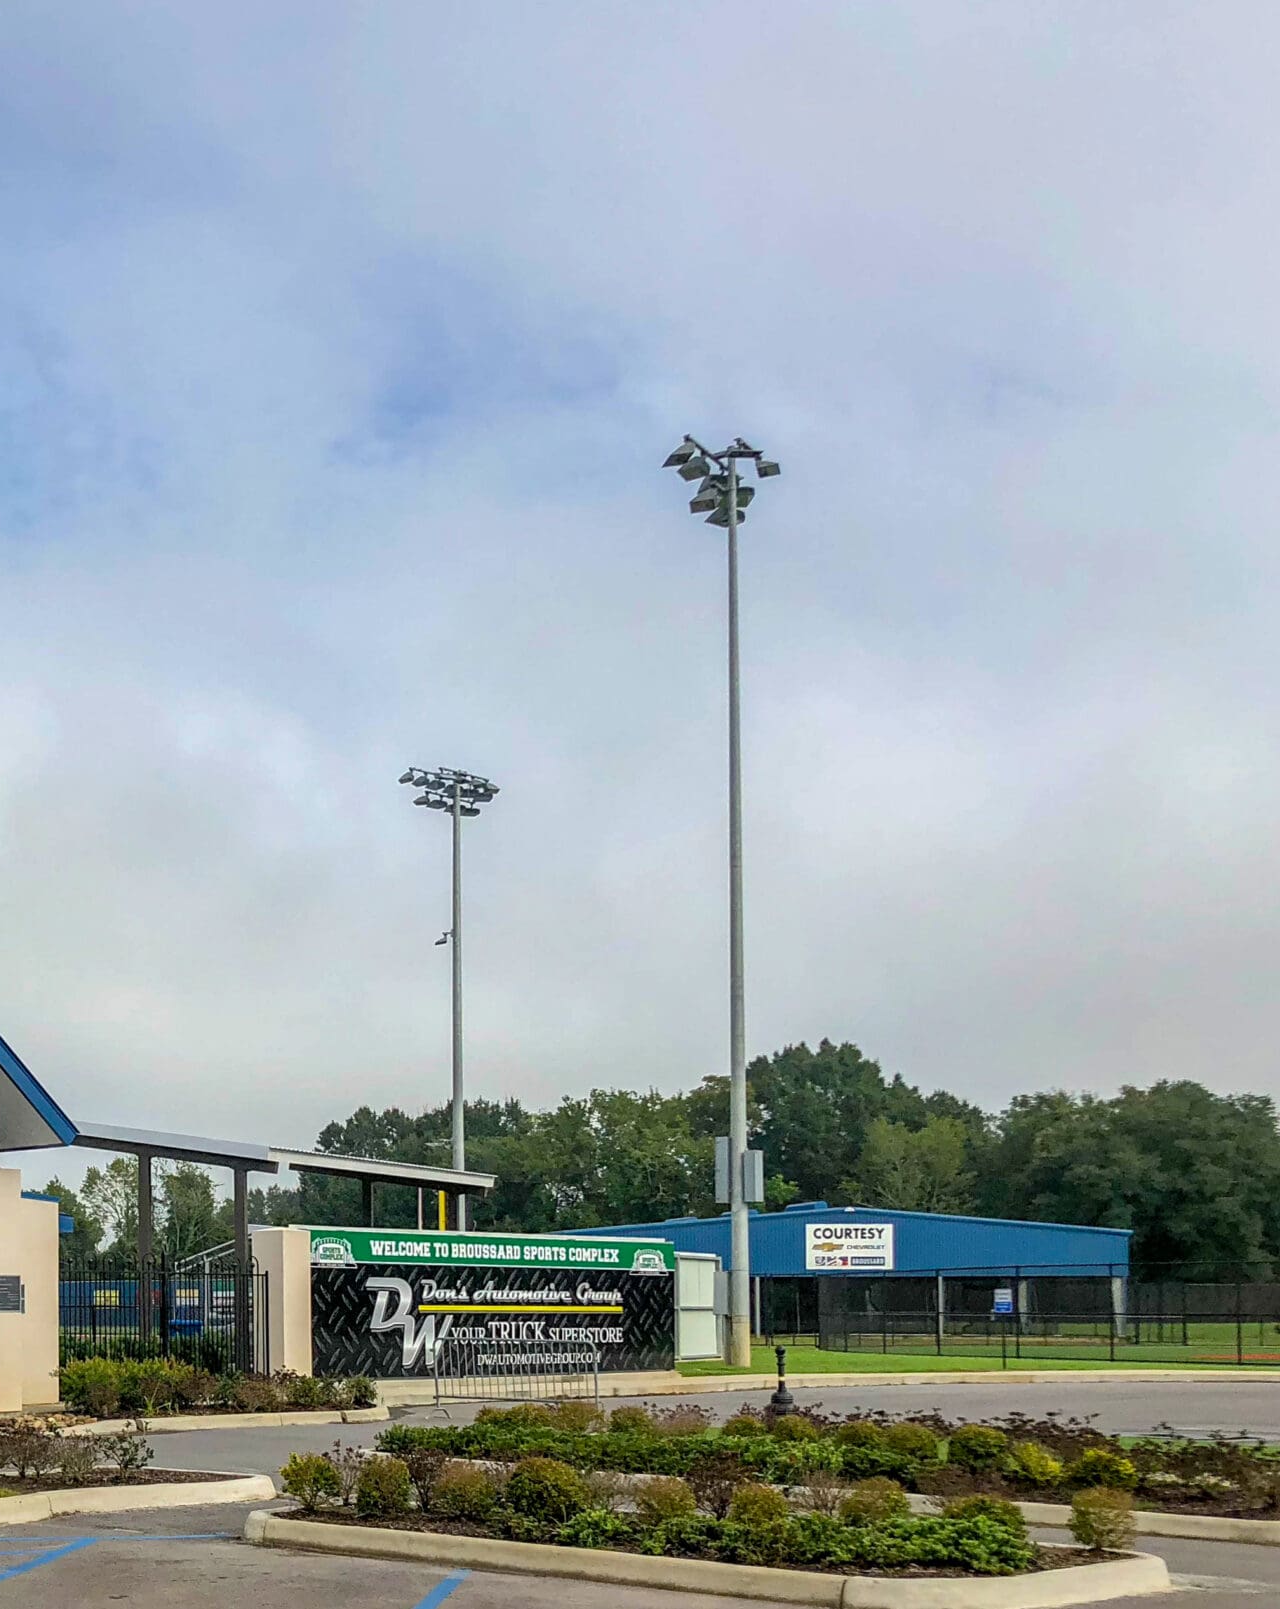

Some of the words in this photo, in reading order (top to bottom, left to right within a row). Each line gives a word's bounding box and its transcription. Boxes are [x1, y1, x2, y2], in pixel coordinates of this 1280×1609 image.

[813, 1228, 885, 1239] COURTESY
[370, 1240, 431, 1258] WELCOME
[434, 1242, 448, 1257] TO
[451, 1243, 521, 1260] BROUSSARD
[523, 1246, 567, 1261] SPORTS
[568, 1248, 620, 1263] COMPLEX
[420, 1279, 470, 1302] Don's
[473, 1280, 573, 1303] Automotive
[576, 1282, 624, 1305] Group
[365, 1277, 453, 1369] DW
[451, 1326, 487, 1344] YOUR
[487, 1321, 546, 1344] TRUCK
[548, 1327, 624, 1343] SUPERSTORE
